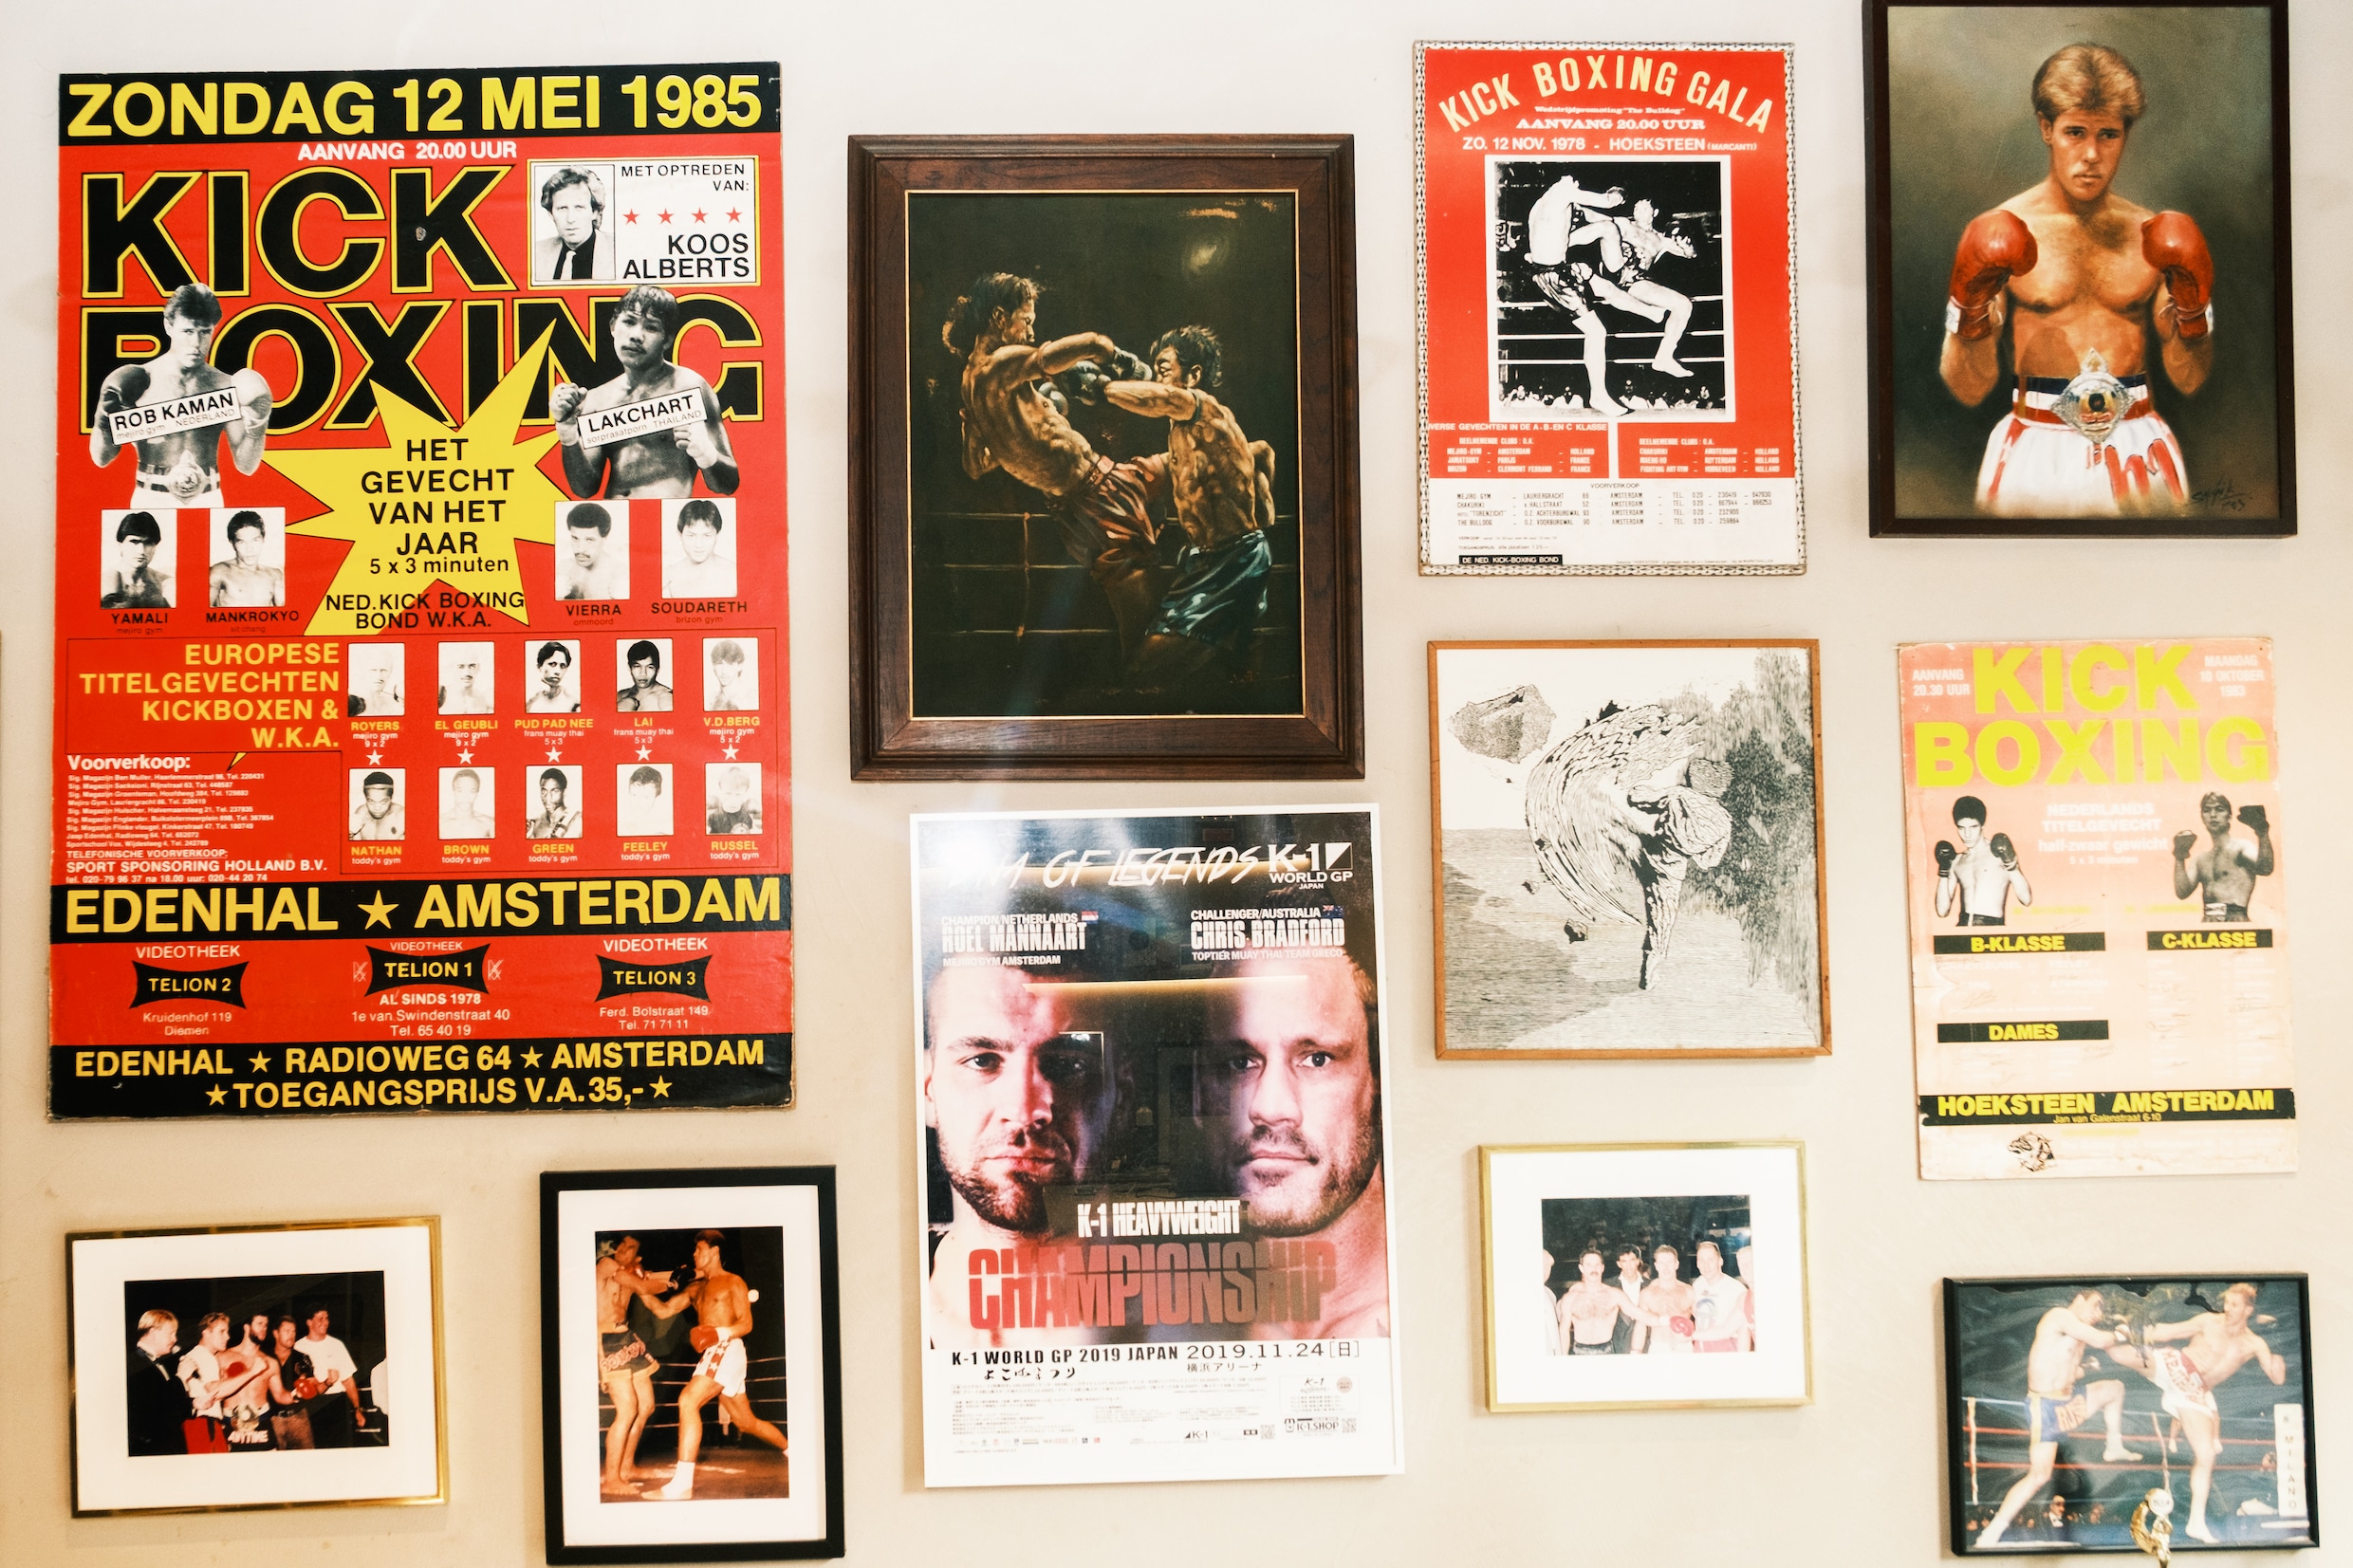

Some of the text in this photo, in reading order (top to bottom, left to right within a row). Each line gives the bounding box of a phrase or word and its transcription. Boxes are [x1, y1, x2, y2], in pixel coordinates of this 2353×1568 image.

[1439, 54, 1773, 134] KICK BOXING GALA
[68, 74, 763, 138] ZONDAG 12 MEI 1985
[1515, 120, 1706, 131] AANVANG 20.00 UUR
[299, 141, 519, 162] AANVANG 20.00 UUR
[1462, 138, 1489, 151] ZO.
[1492, 138, 1509, 151] 12
[1512, 138, 1547, 151] NOV.
[1550, 137, 1585, 151] 1978
[1610, 138, 1705, 151] HOEKSTEEN
[622, 164, 747, 177] MET OPTREDEN
[713, 180, 751, 194] VAN:
[82, 165, 518, 300] KICK
[668, 234, 750, 257] KOOS
[623, 258, 751, 281] ALBERTS
[115, 393, 235, 432] ROB KAMAN
[176, 408, 236, 429] NEDERLAND
[588, 395, 695, 434] LAKCHART
[653, 409, 703, 430] THAILAND
[406, 438, 469, 462] HET
[361, 468, 515, 494] GEVECHT
[369, 500, 507, 525] VAN HET
[397, 531, 478, 556] JAAR
[423, 556, 510, 574] minuten
[439, 590, 525, 611] BOXING
[651, 602, 748, 615] SOUDARETH
[111, 612, 169, 625] YAMALI
[206, 610, 300, 623] MANKROKYO
[565, 604, 622, 617] VIERRA
[356, 611, 491, 631] BOND W.K.A.
[185, 642, 340, 666] EUROPESE
[2204, 655, 2258, 668] MAANDAG
[79, 671, 339, 695] TITELGEVECHTEN
[1912, 670, 1964, 682] AANVANG
[1973, 643, 2201, 715] KICK
[2199, 670, 2265, 683] 10 OKTOBER
[1913, 683, 1971, 697] 20.30 UUR
[142, 698, 340, 722] KICKBOXEN &
[351, 721, 400, 731] ROYERS
[435, 720, 499, 730] EL GEUBLI
[515, 718, 594, 729] PUD PAD NEE
[634, 717, 654, 728] LAI
[704, 716, 761, 728] V.D.BERG
[250, 727, 340, 748] W.K.A.
[1913, 715, 2271, 789] BOXING
[67, 754, 192, 775] Voorverkoop:
[2041, 819, 2162, 833] TITELGEVECHT
[66, 848, 229, 858] TELEFONISCHE VOORVERKOOP:
[351, 845, 402, 856] NATHAN
[443, 844, 490, 855] BROWN
[532, 842, 575, 854] GREEN
[622, 841, 668, 852] FEELEY
[711, 840, 759, 851] RUSSEL
[66, 859, 327, 873] SPORT SPONSORING HOLLAND B.V.
[1109, 845, 1259, 887] LEGENDS
[1268, 842, 1323, 873] K-1
[1269, 871, 1354, 884] WORLD GP
[67, 876, 781, 933] EDENHAL AMSTERDAM
[990, 922, 1087, 952] MANNAART
[1191, 918, 1345, 950] CHRIS BRADFORD
[2162, 932, 2257, 950] C-KLASSE
[137, 944, 242, 960] VIDEOTHEEK
[390, 941, 464, 952] VIDEOTHEEK
[603, 937, 708, 953] VIDEOTHEEK
[1971, 935, 2066, 953] B-KLASSE
[1001, 954, 1062, 966] AMSTERDAM
[1192, 950, 1229, 961] TOPTIER
[384, 962, 472, 979] TELION 1
[613, 971, 698, 986] TELION 3
[149, 977, 233, 992] TELION 2
[380, 993, 482, 1005] AL SINDS 1978
[143, 1010, 233, 1023] Kruidenhof 119
[601, 1005, 708, 1018] Ferd. Bolstraat 149
[165, 1024, 211, 1036] Diemen
[1988, 1024, 2060, 1042] DAMES
[76, 1040, 765, 1078] EDENHAL RADIOWEG 64 AMSTERDAM
[233, 1077, 645, 1109] TOEGANGSPRIJS V.A. 35,-
[1937, 1089, 2275, 1117] HOEKSTEEN AMSTERDAM
[1078, 1200, 1241, 1238] K-1 HEAVYWEIGHT
[969, 1240, 1339, 1330] CHAMPIONSHIP
[952, 1346, 1178, 1366] K-1 WORLD GP 2019 JAPAN
[1187, 1342, 1324, 1359] 2019.11.24
